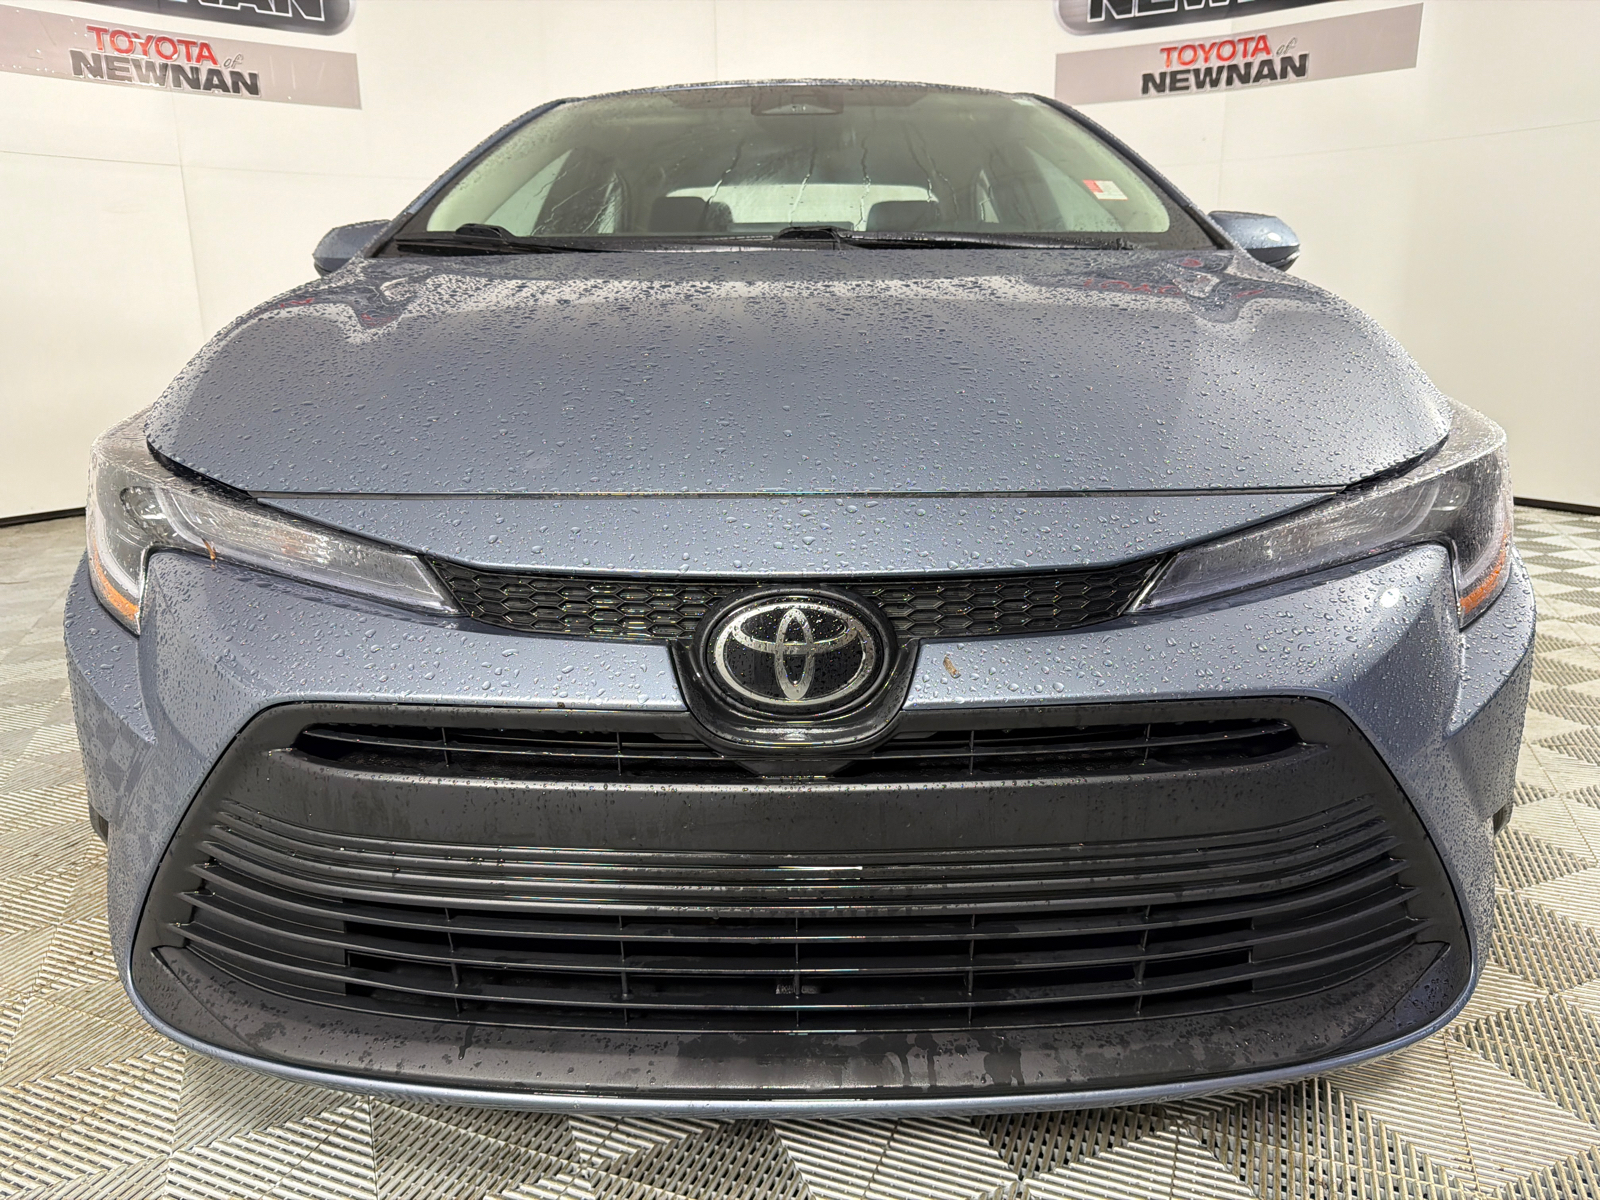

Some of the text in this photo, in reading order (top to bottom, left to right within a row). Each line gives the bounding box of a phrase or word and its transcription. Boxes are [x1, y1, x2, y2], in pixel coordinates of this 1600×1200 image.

[86, 25, 243, 69] TOYOTA of
[1160, 34, 1298, 69] TOYOTA of
[69, 49, 261, 96] NEWNAN
[1141, 53, 1309, 95] NEWNAN
